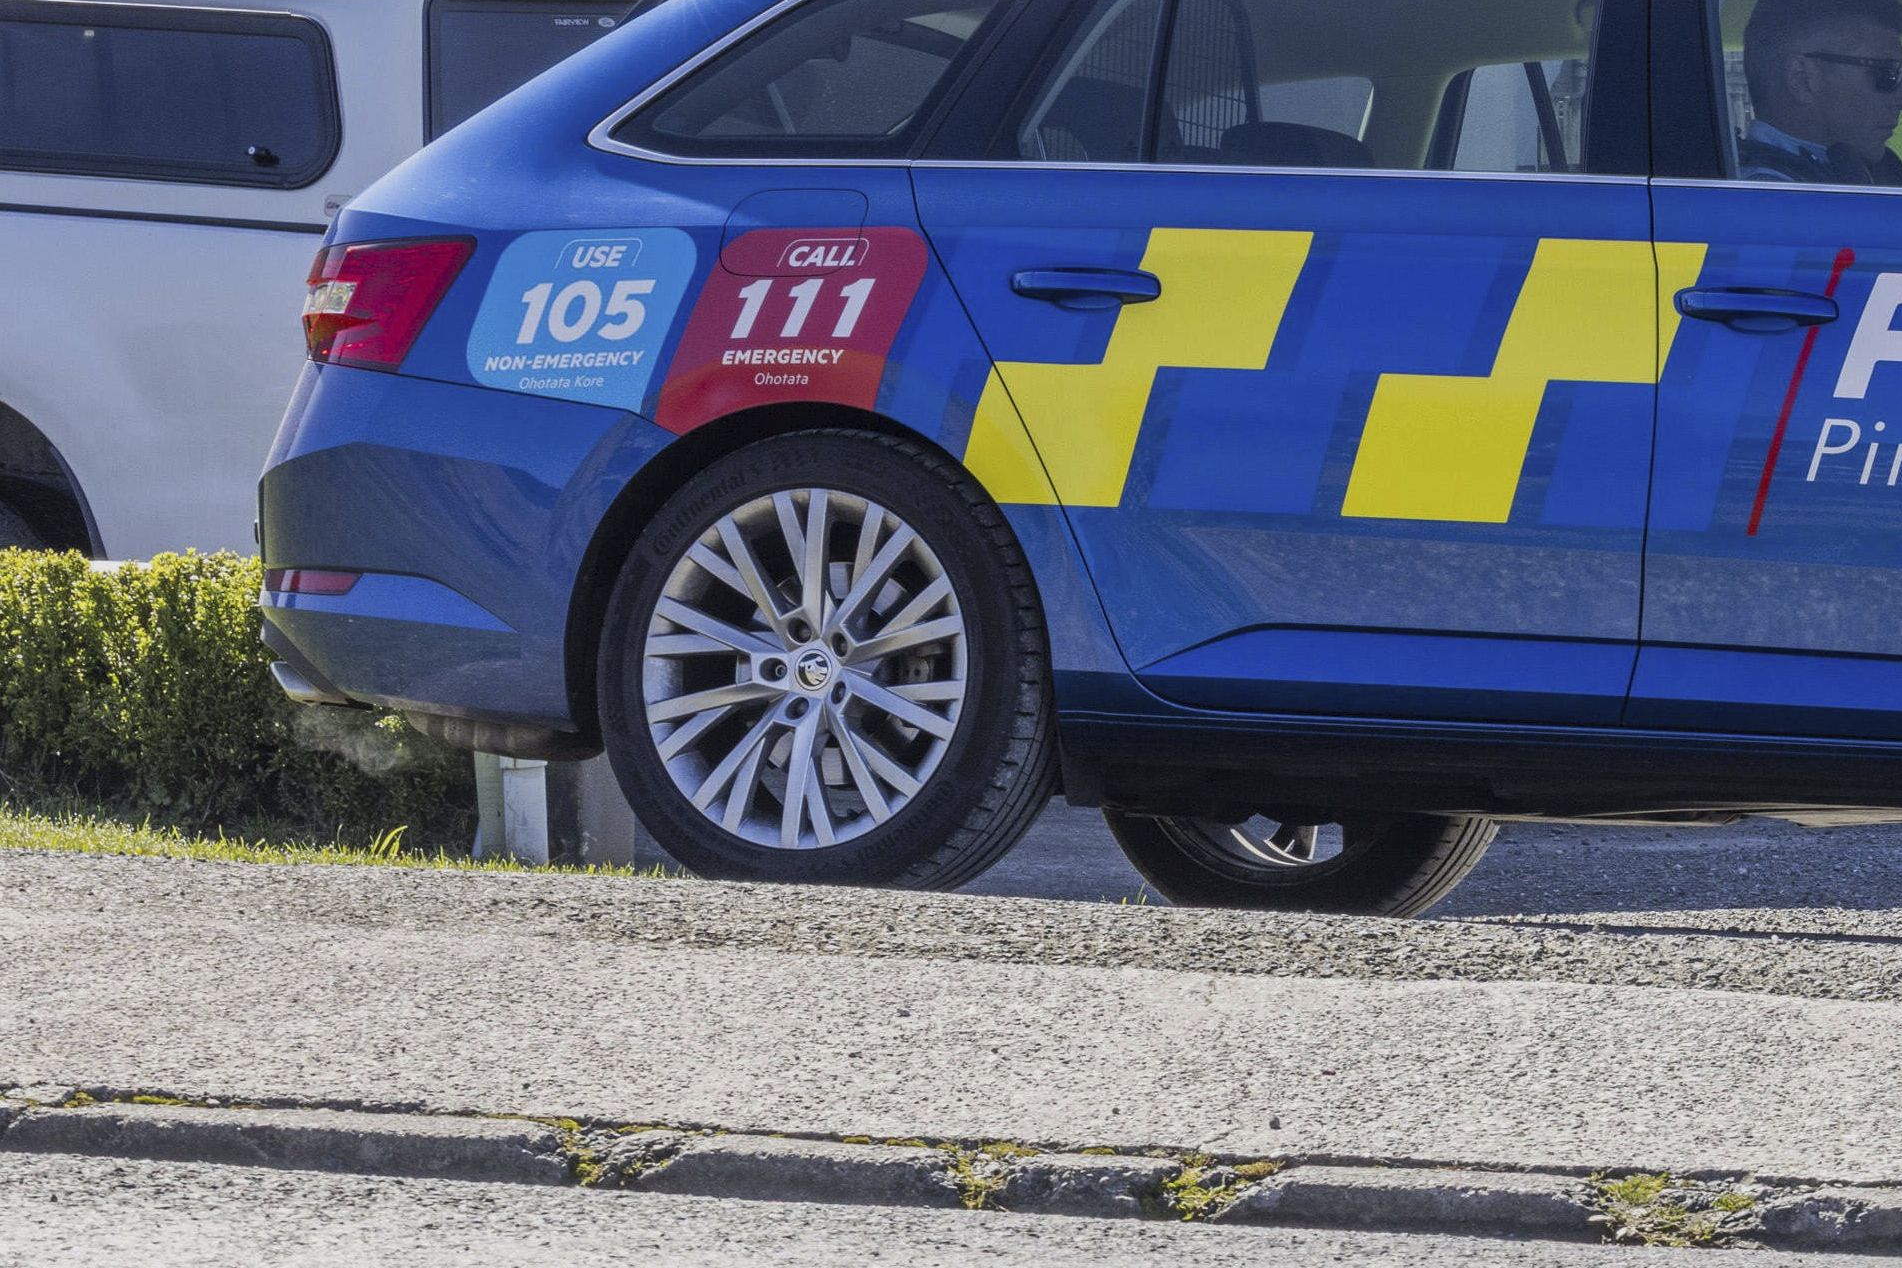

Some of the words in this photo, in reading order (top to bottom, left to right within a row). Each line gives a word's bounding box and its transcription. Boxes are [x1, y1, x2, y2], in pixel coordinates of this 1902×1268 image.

[573, 244, 624, 268] USE
[788, 245, 856, 267] CALL
[516, 279, 656, 344] 105
[730, 278, 876, 339] 111
[484, 350, 645, 372] NON-EMERGENCY
[721, 349, 845, 365] EMERGENCY
[519, 376, 570, 390] Ohotata
[574, 374, 605, 387] Kore
[754, 372, 809, 385] Ohotata
